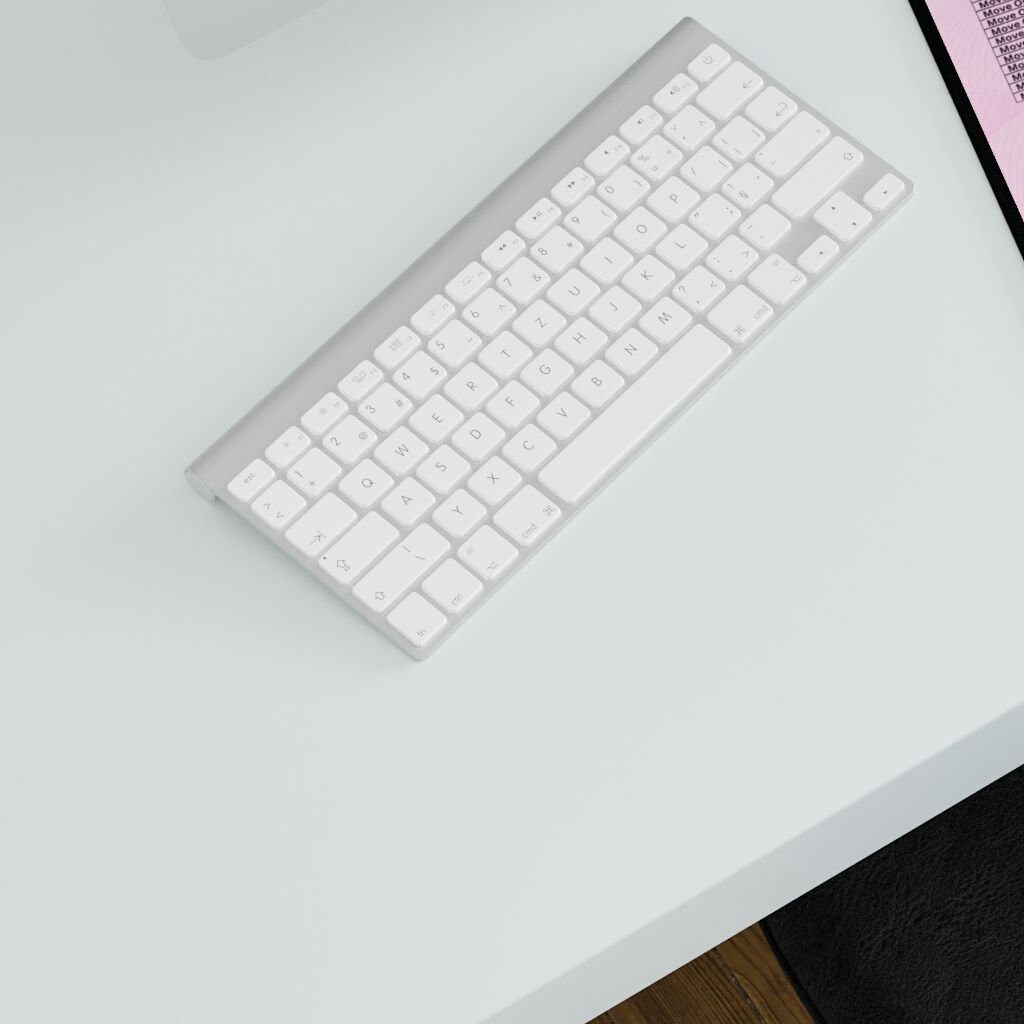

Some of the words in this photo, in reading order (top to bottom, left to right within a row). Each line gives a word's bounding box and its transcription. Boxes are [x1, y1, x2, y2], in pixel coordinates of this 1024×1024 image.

[982, 4, 1012, 18] Move
[640, 270, 654, 281] K
[658, 312, 673, 325] M
[574, 332, 586, 344] H
[500, 349, 512, 361] T
[624, 344, 638, 355] N
[539, 364, 551, 376] G
[466, 380, 479, 392] R
[505, 396, 516, 407] F
[431, 412, 444, 424] E
[470, 428, 483, 440] D
[395, 443, 410, 457] W
[523, 440, 535, 452] C
[436, 461, 448, 472] S
[401, 494, 413, 505] A
